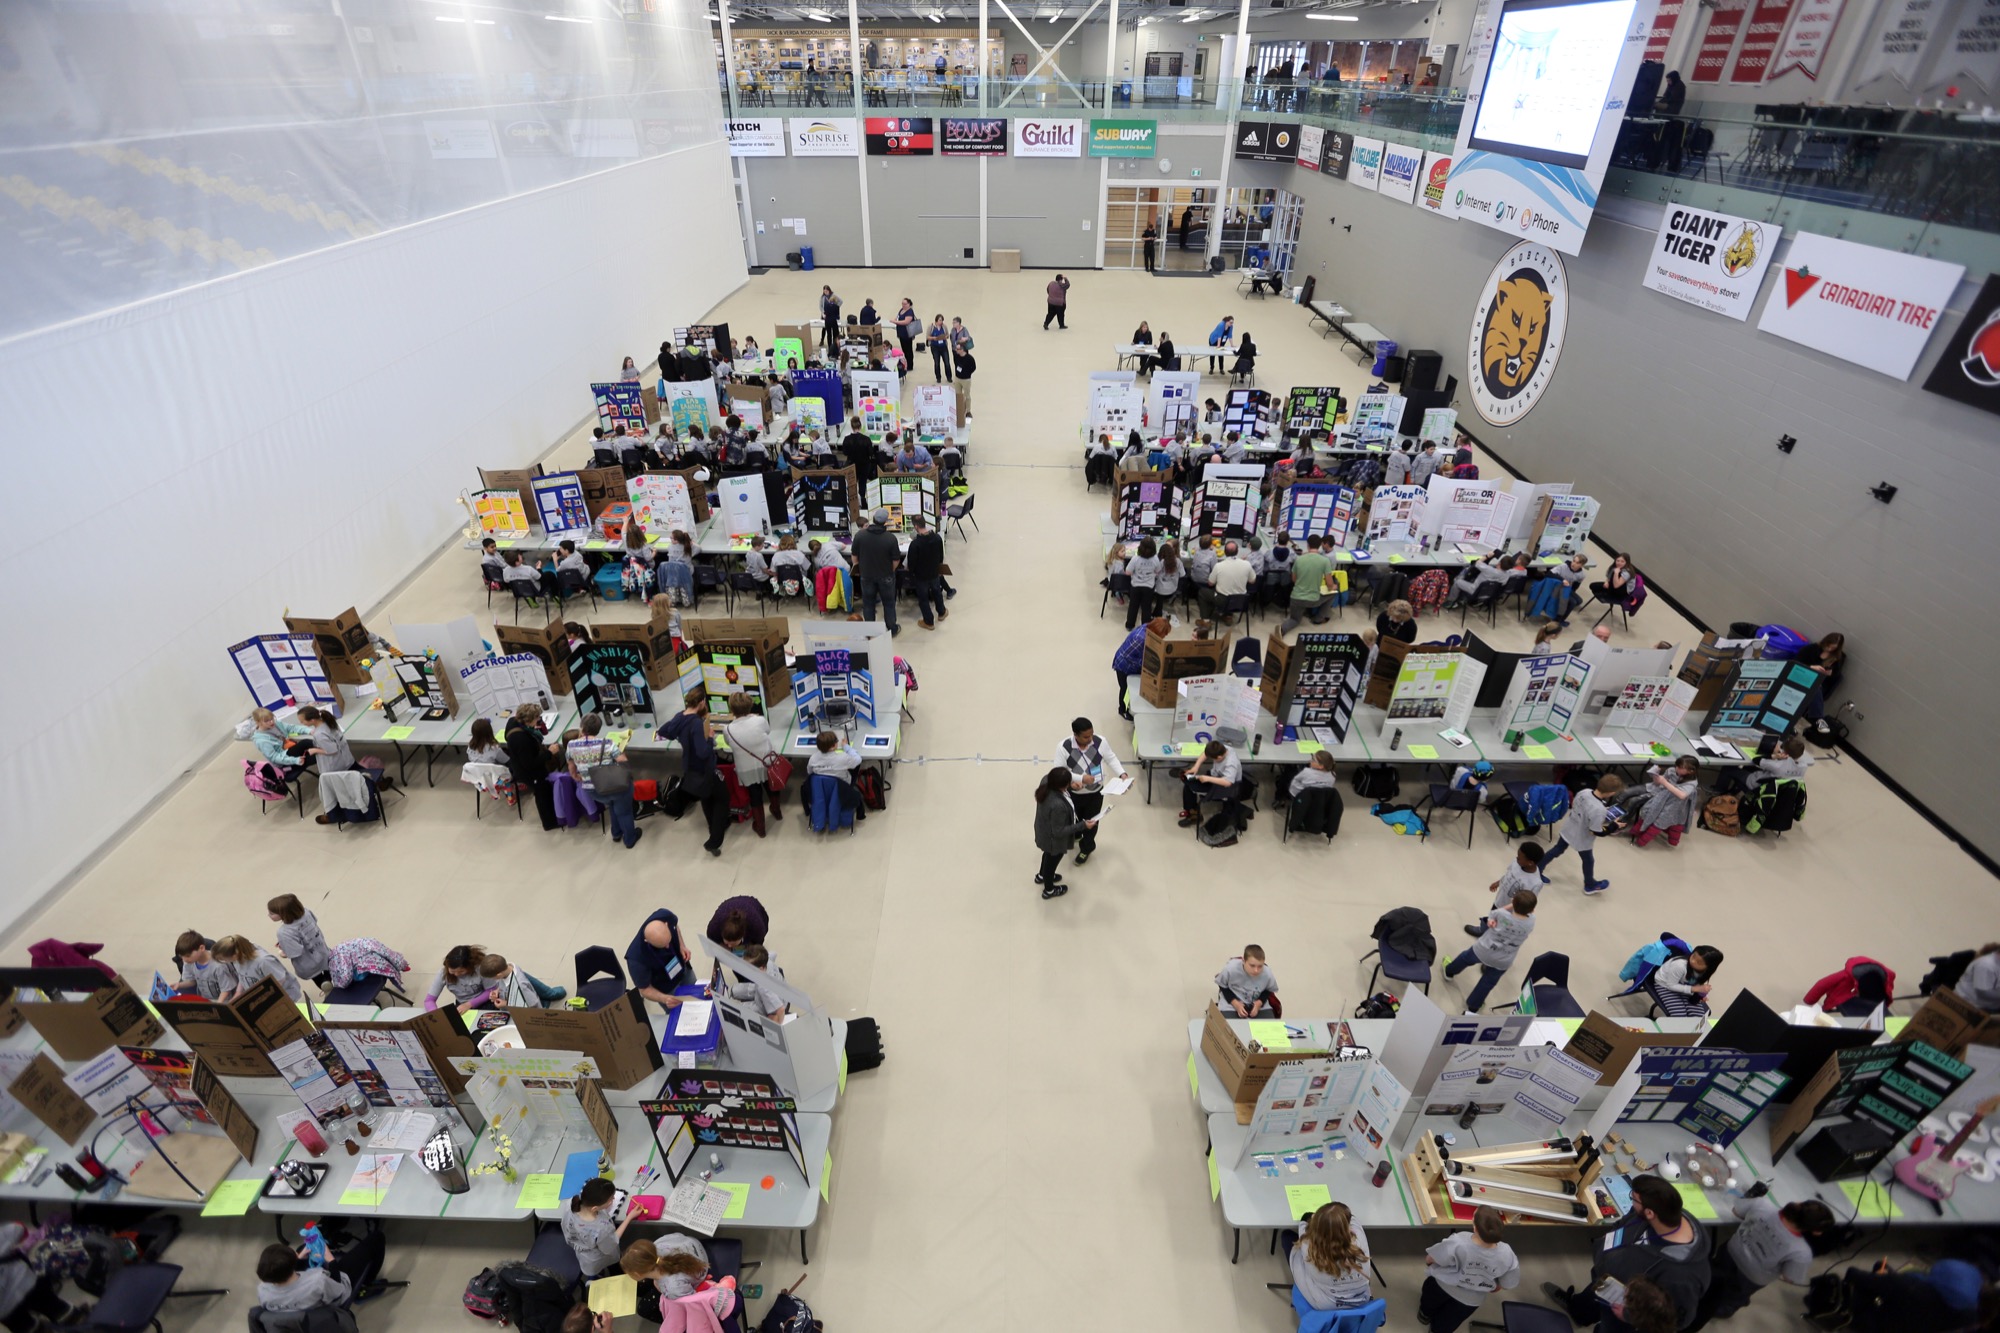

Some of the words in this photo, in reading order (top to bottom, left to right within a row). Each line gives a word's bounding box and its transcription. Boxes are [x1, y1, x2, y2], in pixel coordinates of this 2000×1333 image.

[730, 123, 761, 131] KOCH
[1022, 123, 1074, 146] Guild
[1094, 128, 1151, 140] SUBWAY
[800, 133, 849, 146] SUNRISE
[1385, 153, 1418, 176] MURRAY
[1363, 167, 1375, 180] Travel
[1464, 194, 1491, 213] Internet
[1506, 206, 1517, 220] TV
[1532, 213, 1559, 234] Phone
[1670, 210, 1728, 241] GIANT
[1664, 233, 1715, 265] TIGER
[1510, 250, 1557, 284] BOBCATS
[1657, 266, 1668, 276] Your
[1668, 270, 1718, 294] saveoneverything
[1719, 287, 1740, 300] store!
[1667, 286, 1684, 298] Victoria
[1705, 300, 1726, 313] Brandon
[1819, 281, 1896, 318] CANADIAN
[1896, 301, 1937, 330] TIRE
[1471, 307, 1486, 394] BRANDON
[1489, 343, 1556, 416] UNIVERSITY
[1362, 394, 1392, 402] TITANIC
[1481, 490, 1494, 499] OR
[587, 647, 638, 662] WASHING
[703, 645, 747, 654] SECOND
[816, 651, 849, 663] BLACK
[592, 662, 637, 677] WATER
[818, 662, 850, 673] HOLES
[1325, 1053, 1372, 1064] MATTERS
[1551, 1050, 1596, 1078] Observations
[1670, 1058, 1750, 1070] WATER
[1446, 1071, 1476, 1079] Variables
[1534, 1077, 1574, 1101] Conclusion
[641, 1102, 702, 1113] HEALTHY
[745, 1101, 795, 1110] HANDS
[1518, 1095, 1560, 1122] Applications
